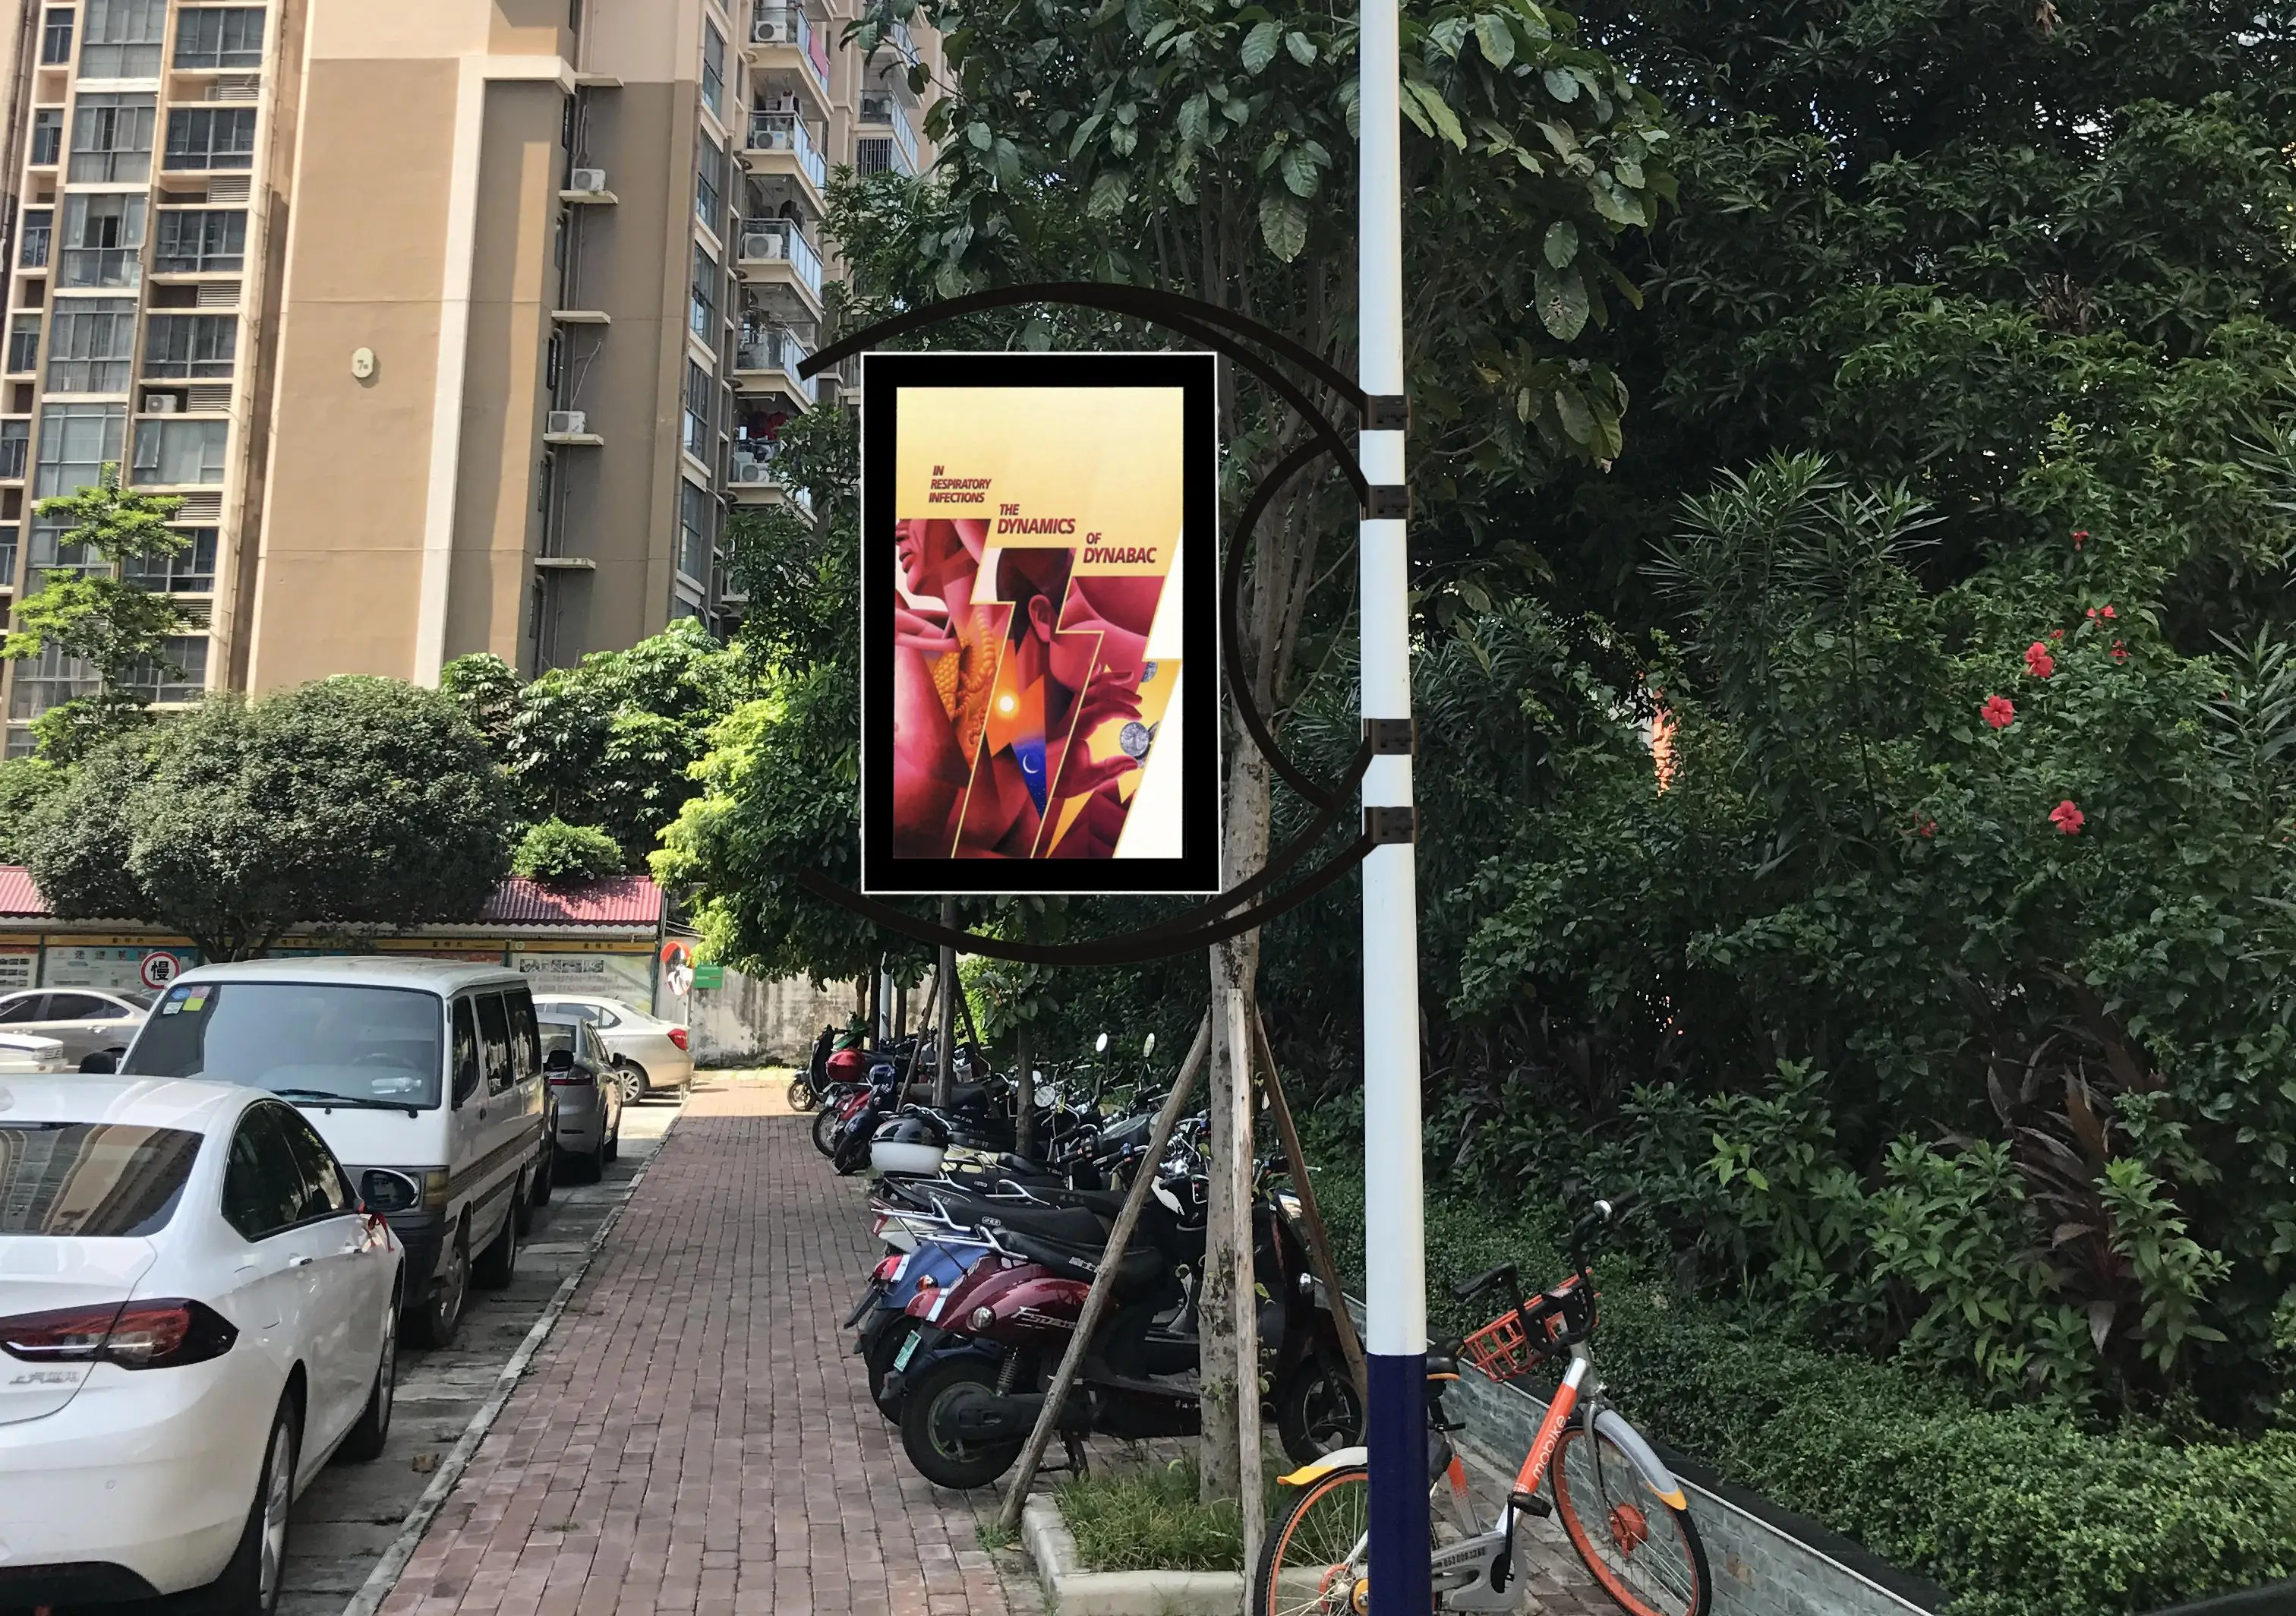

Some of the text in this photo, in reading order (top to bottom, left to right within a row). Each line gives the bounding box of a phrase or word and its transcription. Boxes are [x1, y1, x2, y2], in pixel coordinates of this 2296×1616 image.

[932, 465, 945, 476] IN
[930, 478, 992, 490] RESPIRATORY
[928, 492, 986, 503] INFECTIONS
[998, 503, 1020, 516] THE
[997, 518, 1077, 535] DYNAMICS
[1086, 532, 1102, 544] OF
[1082, 547, 1158, 563] DYNABAC
[150, 960, 169, 981] 慢
[1532, 1415, 1566, 1481] mobike
